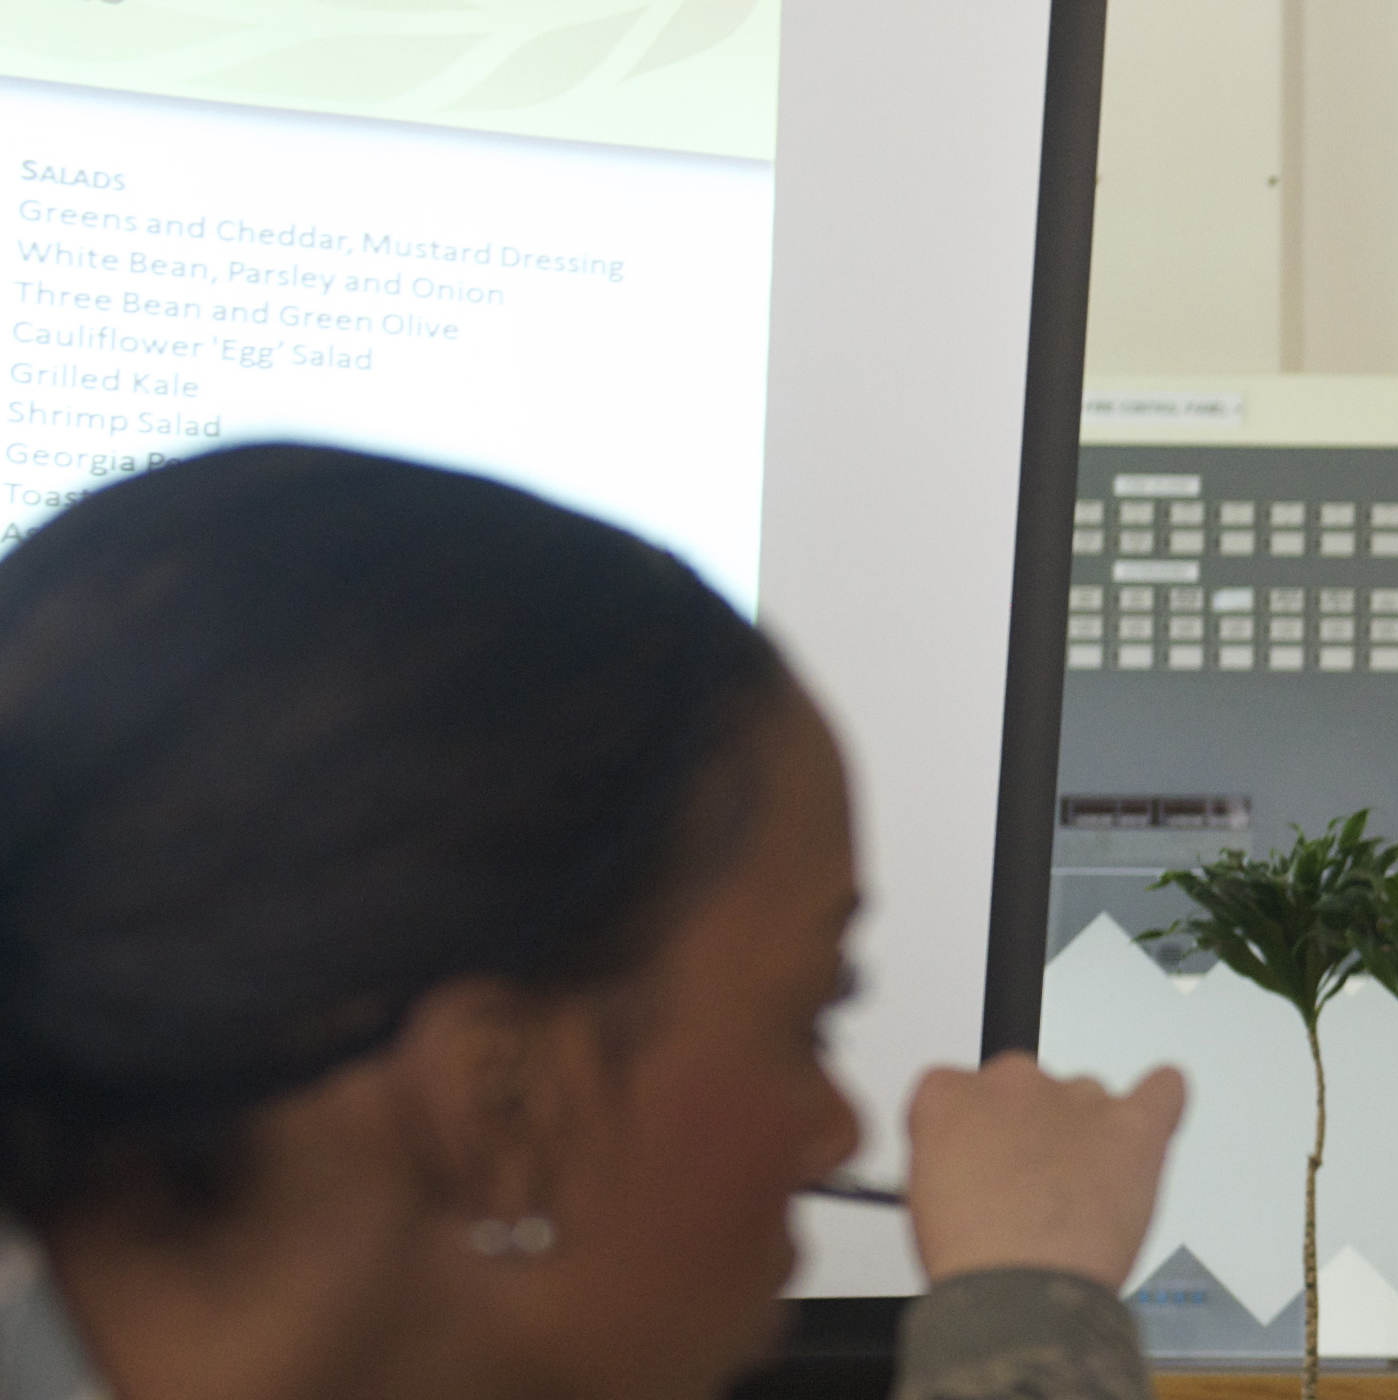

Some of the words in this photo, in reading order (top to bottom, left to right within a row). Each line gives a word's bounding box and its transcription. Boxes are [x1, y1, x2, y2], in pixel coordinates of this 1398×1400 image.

[20, 158, 127, 191] SALADS
[19, 199, 137, 232] Greens
[146, 215, 206, 239] and
[216, 219, 354, 257] Cheddar,
[362, 231, 491, 266] Mustard
[501, 245, 625, 283] Dressing
[17, 239, 119, 271] White
[130, 251, 218, 285] Bean,
[229, 260, 336, 296] Parsley
[345, 272, 402, 295] and
[412, 276, 504, 305] Onion
[14, 279, 112, 311] Three
[122, 291, 201, 319] Bean
[212, 301, 270, 325] and
[280, 305, 373, 333] Green
[382, 313, 460, 340] Olive
[13, 320, 202, 357] Cauliflower
[293, 344, 373, 371] Salad
[10, 361, 120, 392] Grilled
[133, 372, 199, 398] Kale
[8, 401, 128, 436] Shrimp
[138, 412, 221, 437] Salad
[6, 441, 135, 476] Georgia
